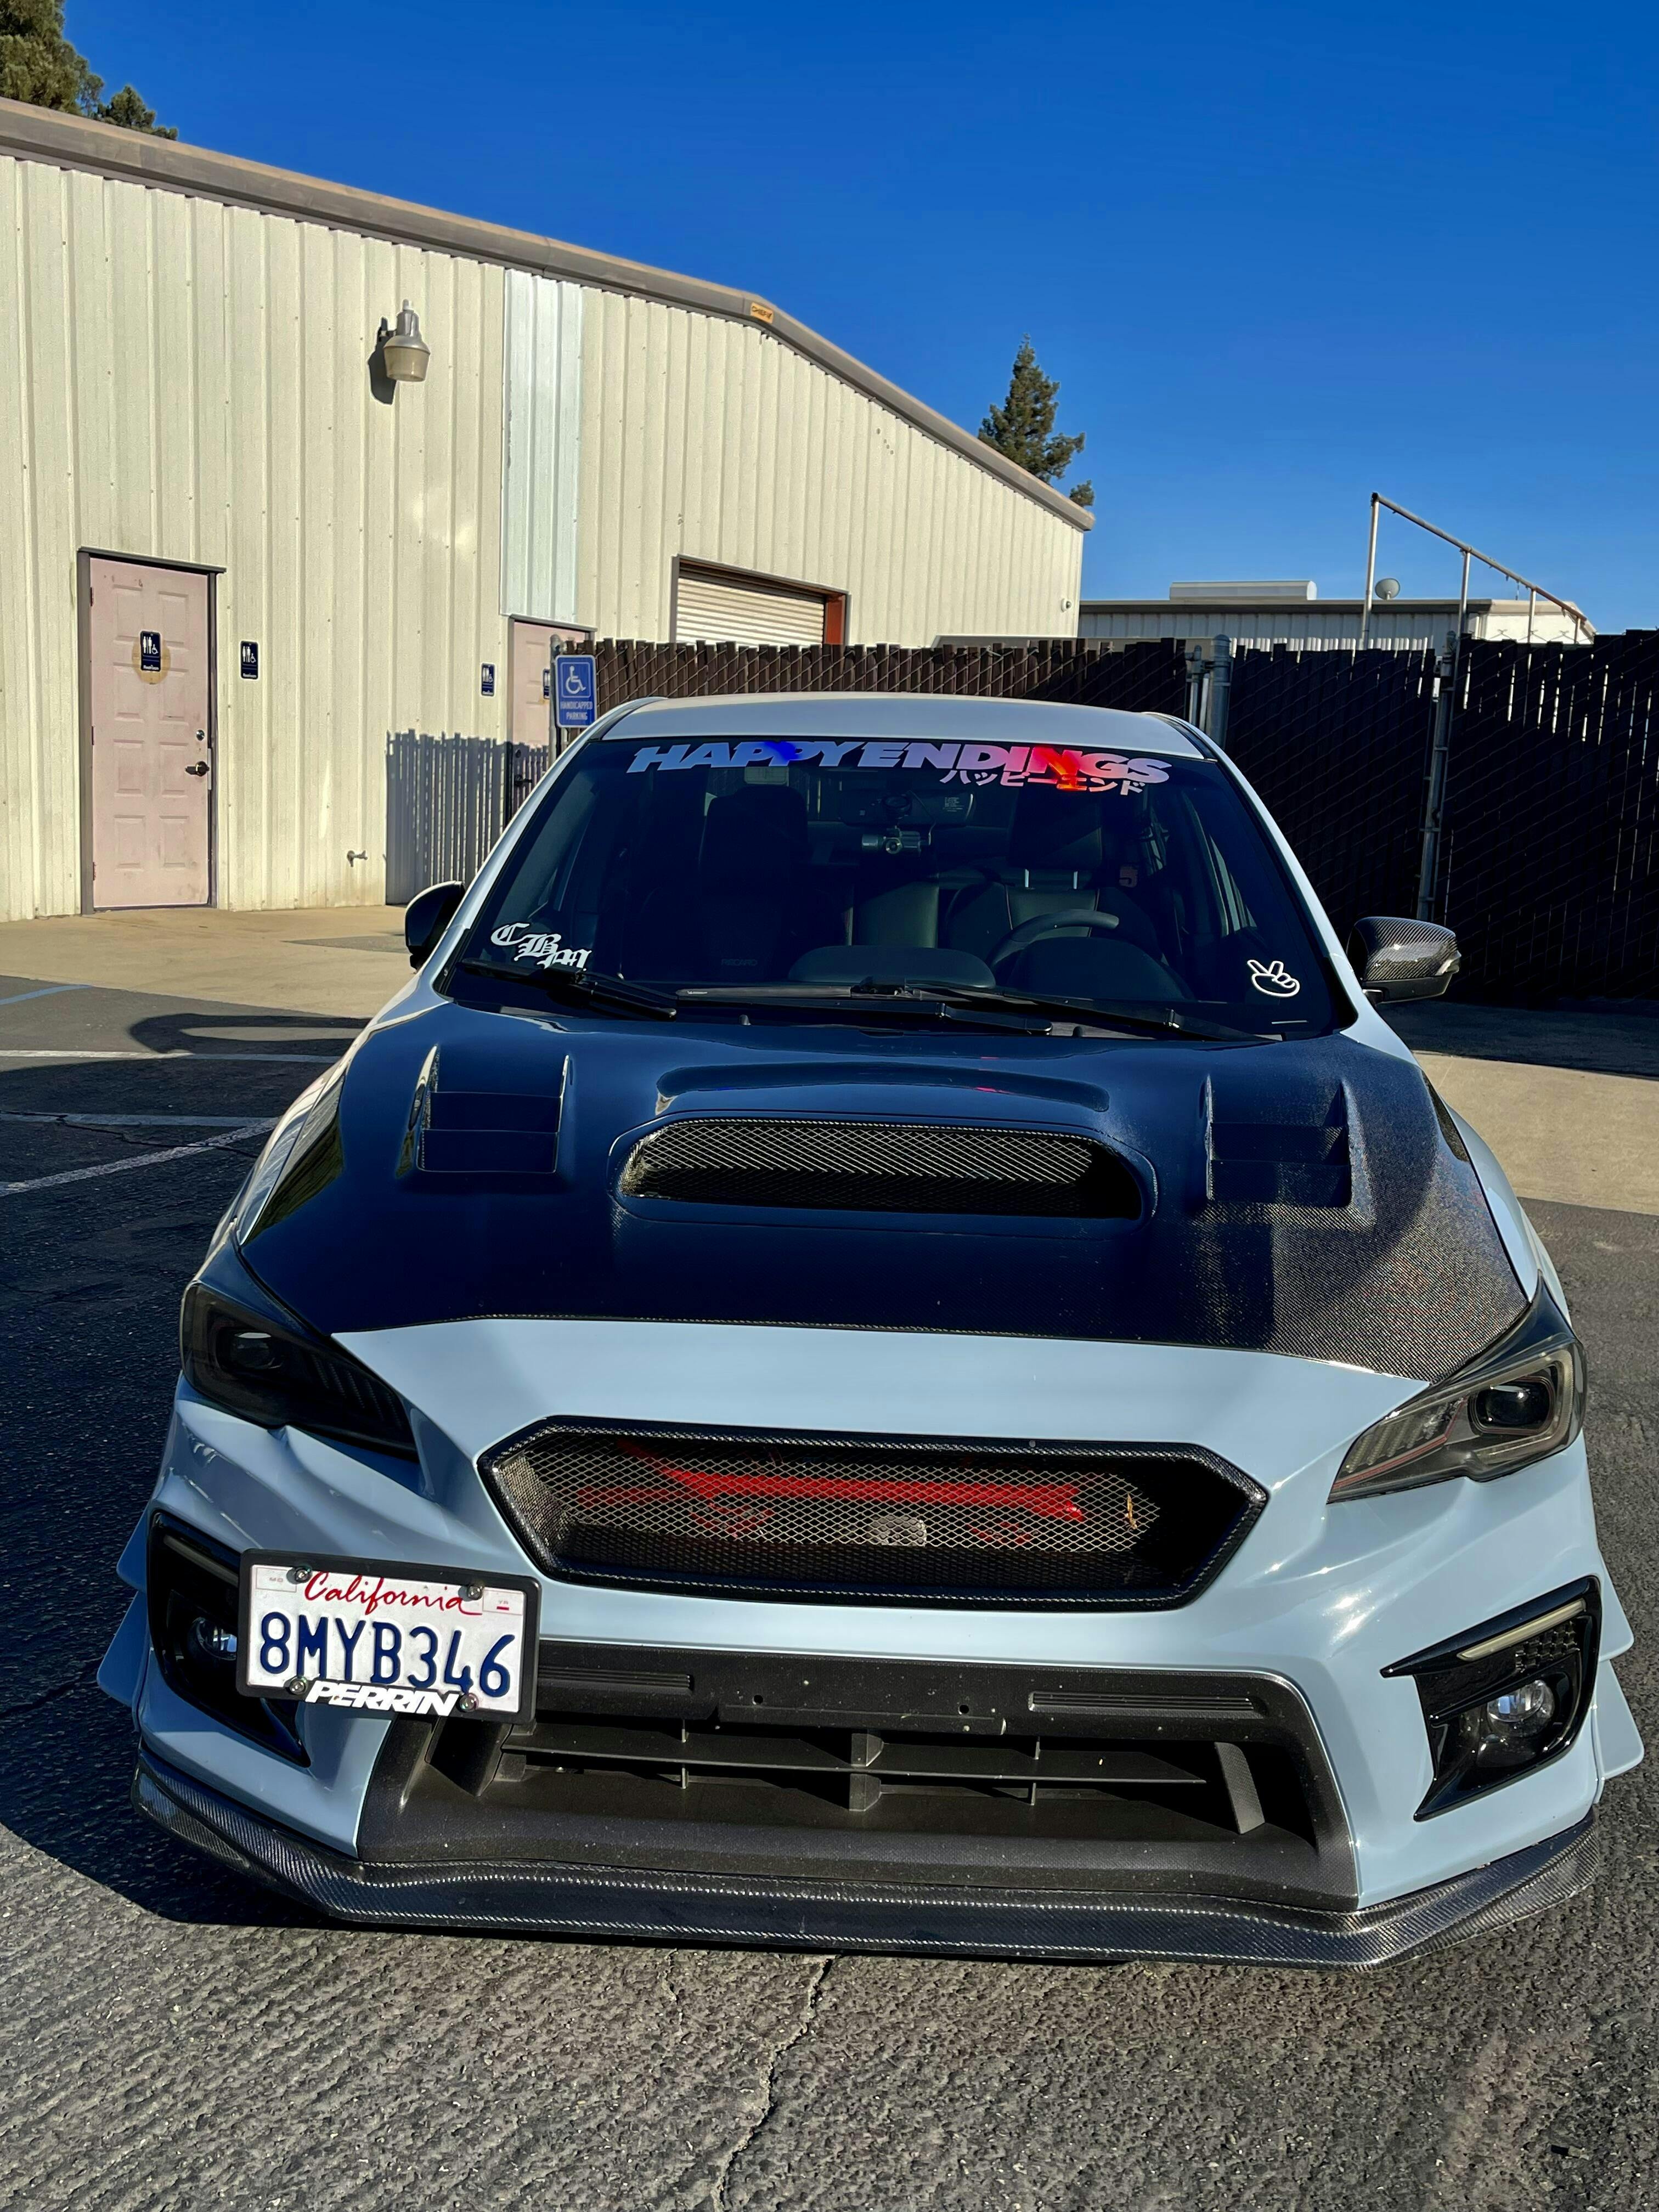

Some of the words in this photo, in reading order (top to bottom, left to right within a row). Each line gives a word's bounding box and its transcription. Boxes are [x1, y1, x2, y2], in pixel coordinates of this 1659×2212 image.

[566, 712, 588, 720] PARKING
[304, 1571, 483, 1616] California
[259, 1611, 515, 1697] 8MYB346
[305, 1680, 459, 1717] PERRIN
